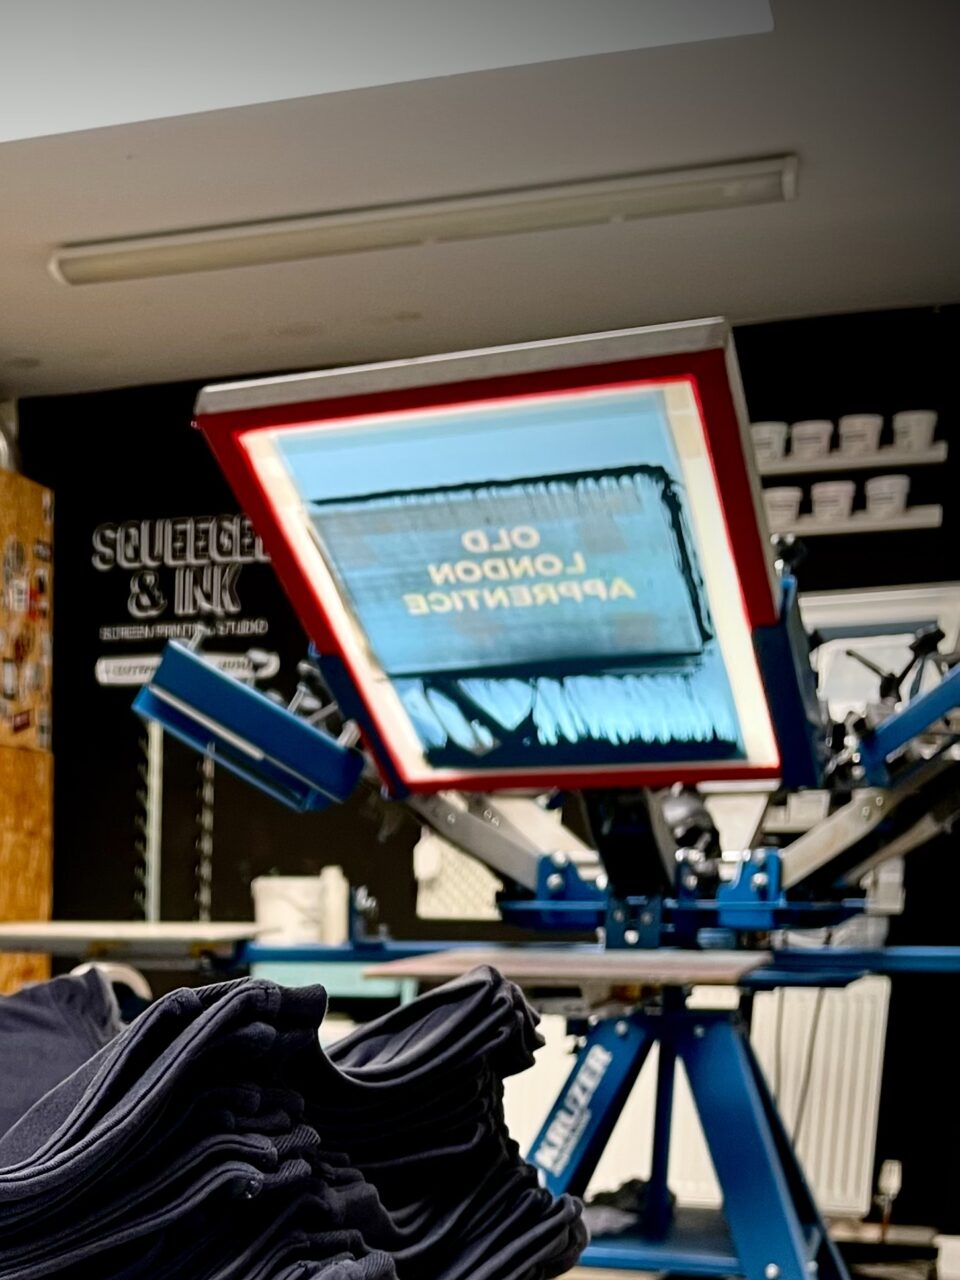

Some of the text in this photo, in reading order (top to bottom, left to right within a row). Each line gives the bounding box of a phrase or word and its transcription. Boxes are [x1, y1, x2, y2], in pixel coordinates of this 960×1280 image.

[127, 564, 242, 617] & INK
[534, 1044, 612, 1169] KRUZER
